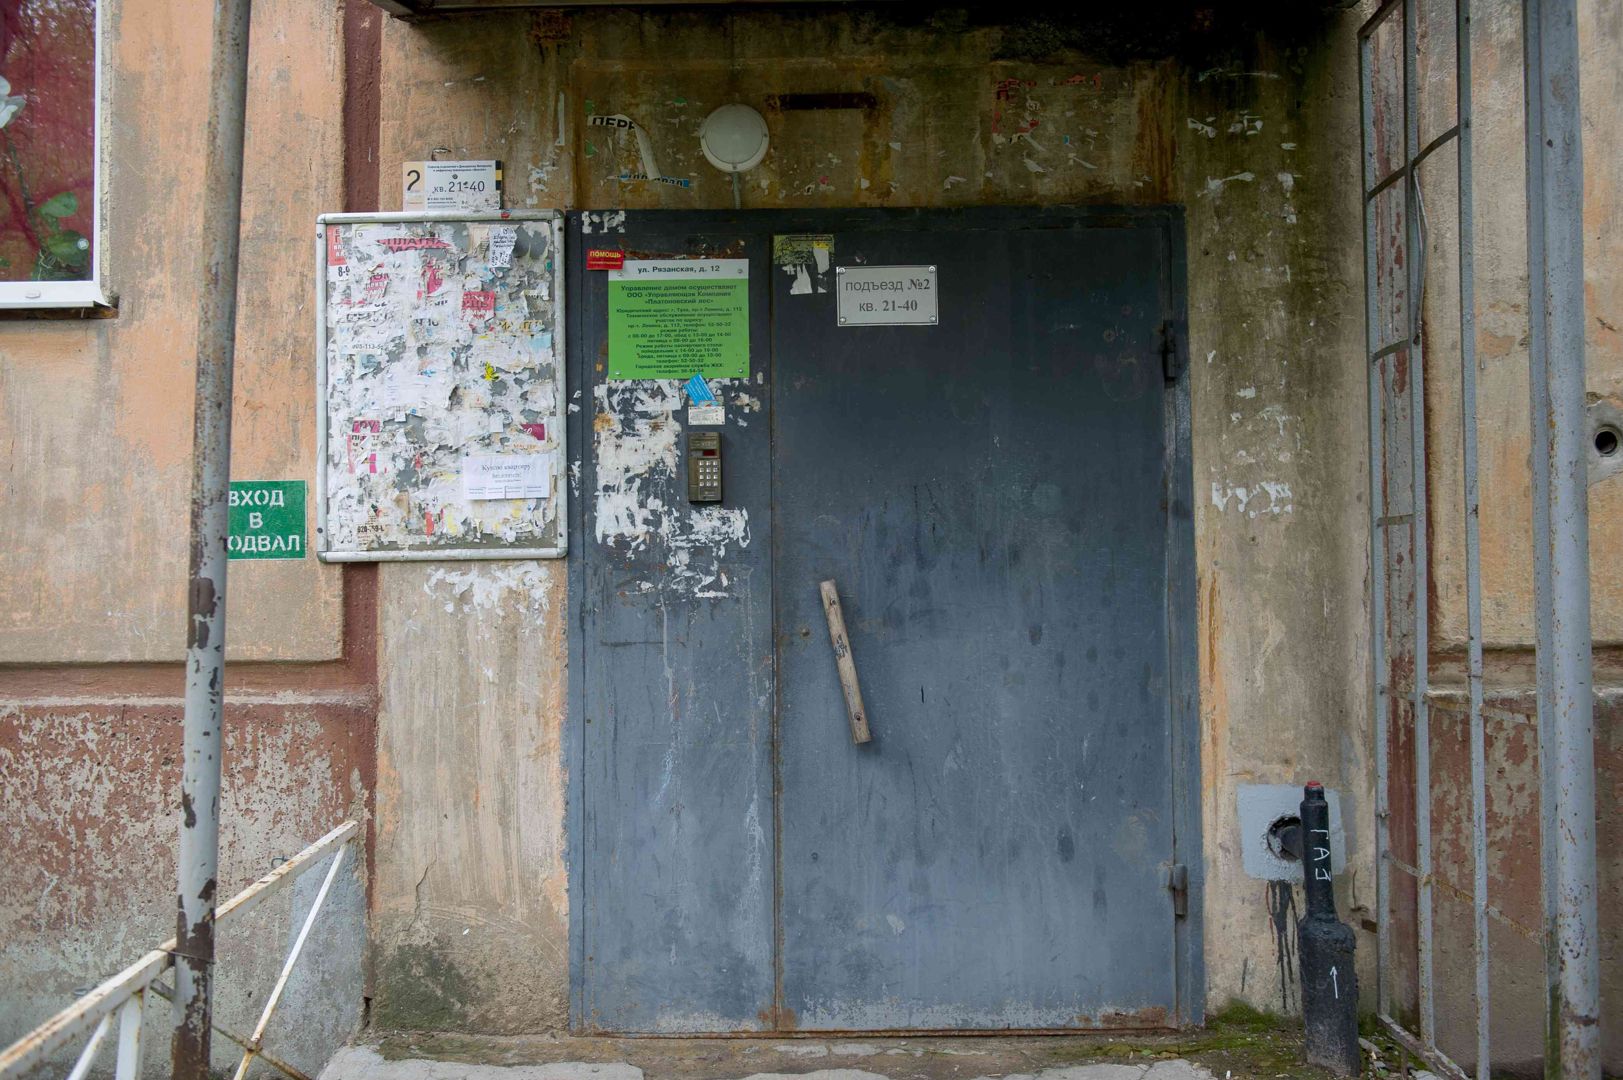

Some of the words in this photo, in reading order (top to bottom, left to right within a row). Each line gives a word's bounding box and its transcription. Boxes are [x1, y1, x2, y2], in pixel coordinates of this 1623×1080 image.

[448, 180, 485, 192] 21-40
[652, 266, 696, 274] Рязанская,
[859, 303, 878, 312] кв.
[882, 300, 918, 312] 21-40
[228, 489, 284, 508] ВХОД
[249, 512, 263, 529] В
[227, 535, 300, 554] ОДВАЛ
[1310, 828, 1332, 882] ГАЗ
